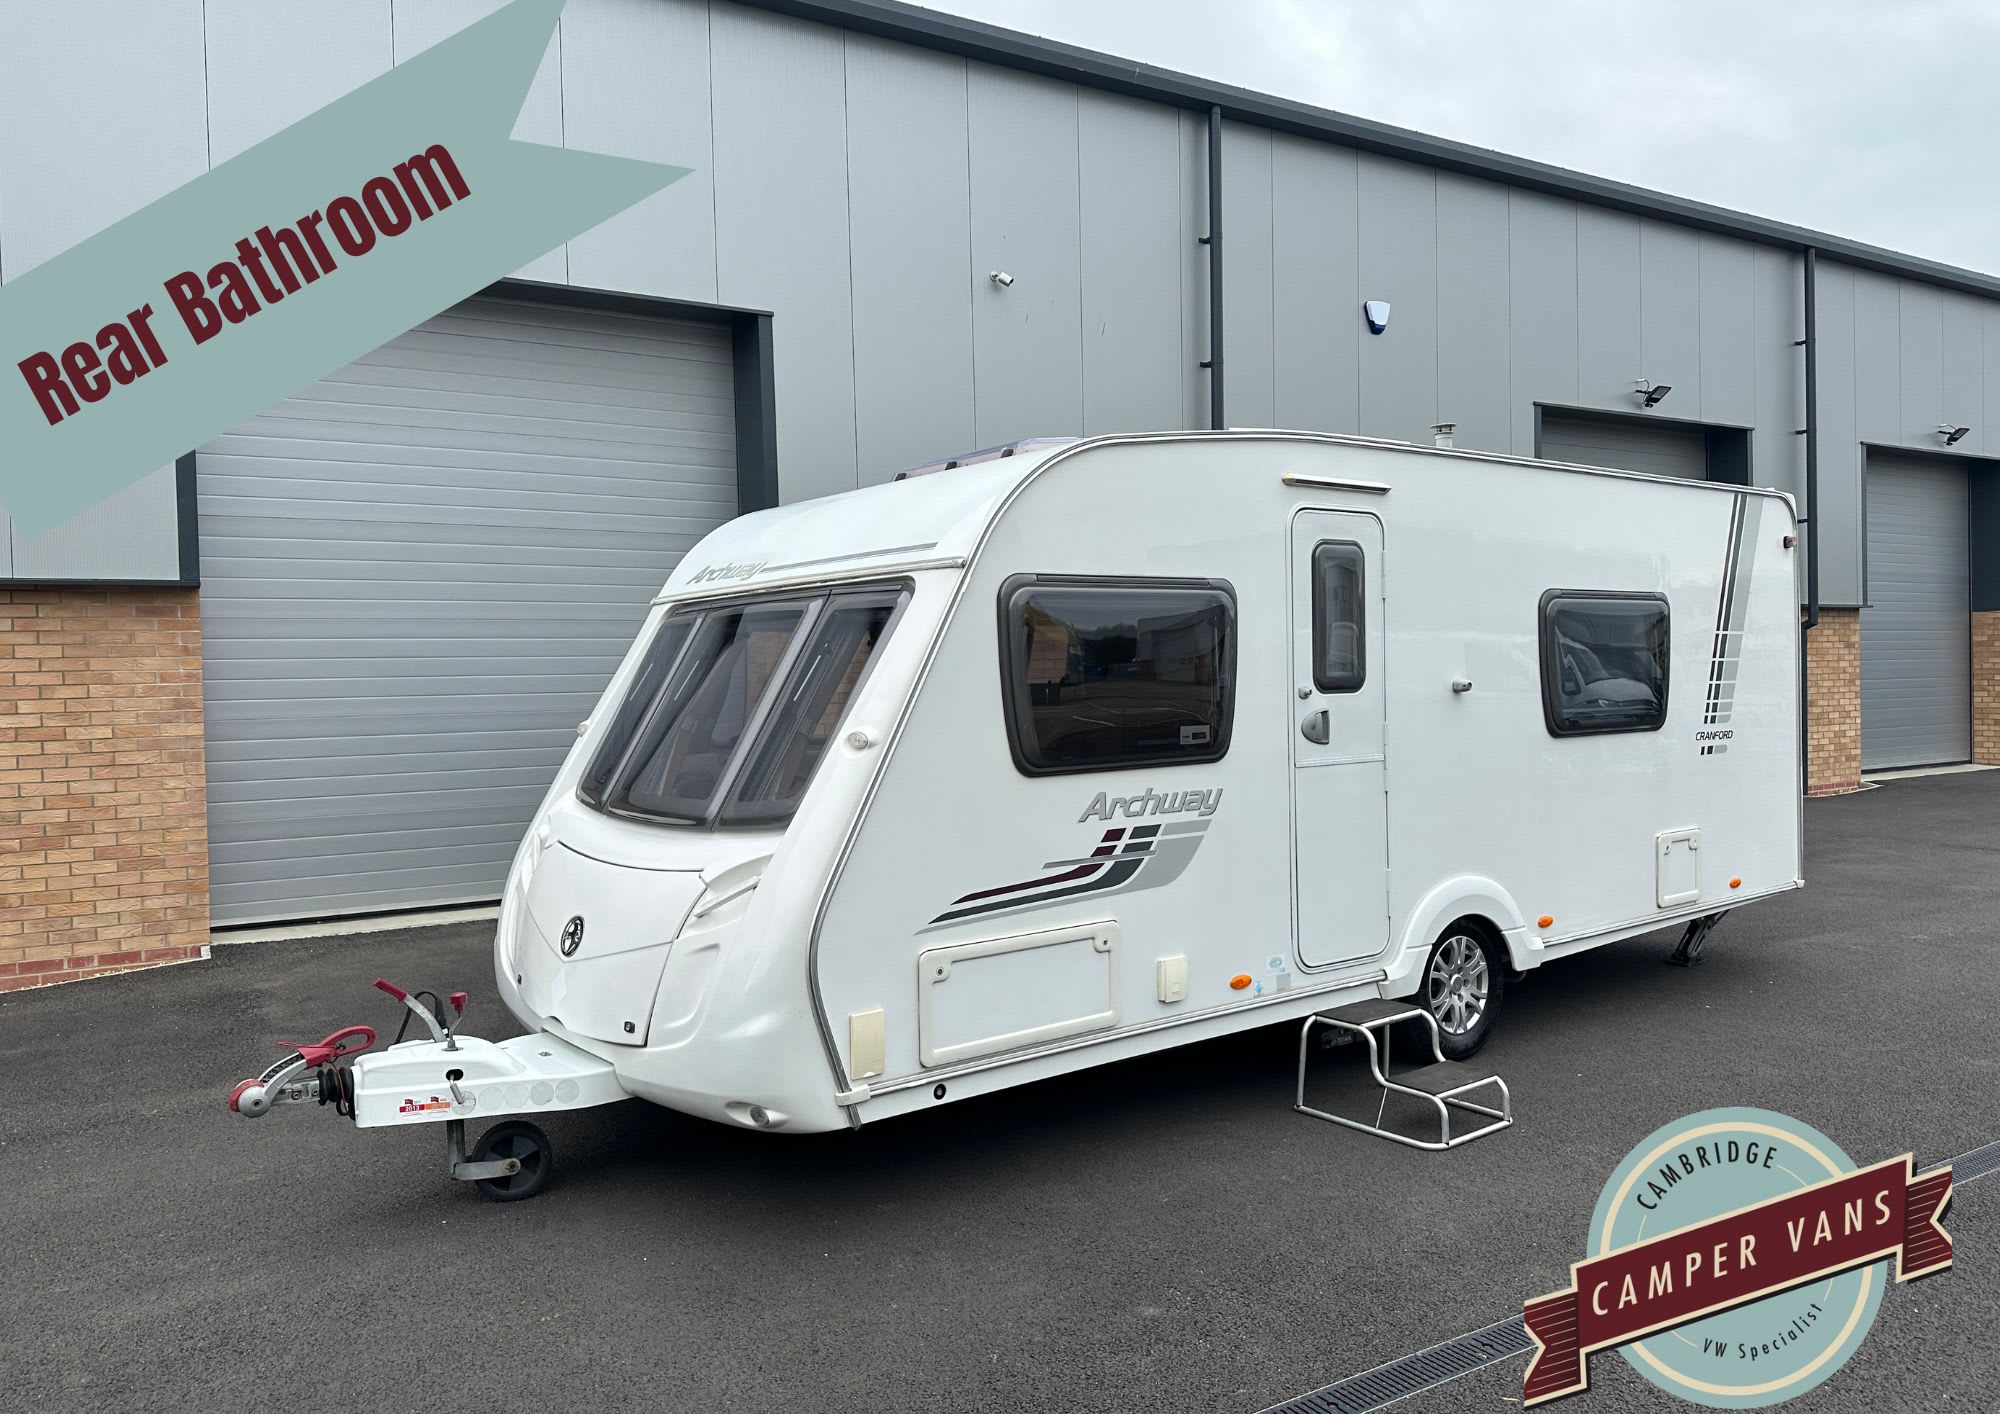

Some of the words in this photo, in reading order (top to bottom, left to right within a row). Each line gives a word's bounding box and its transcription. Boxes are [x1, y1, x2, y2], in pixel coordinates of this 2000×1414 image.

[685, 562, 767, 584] Archway
[1695, 729, 1734, 741] CRANFORD
[1077, 787, 1224, 823] Archway
